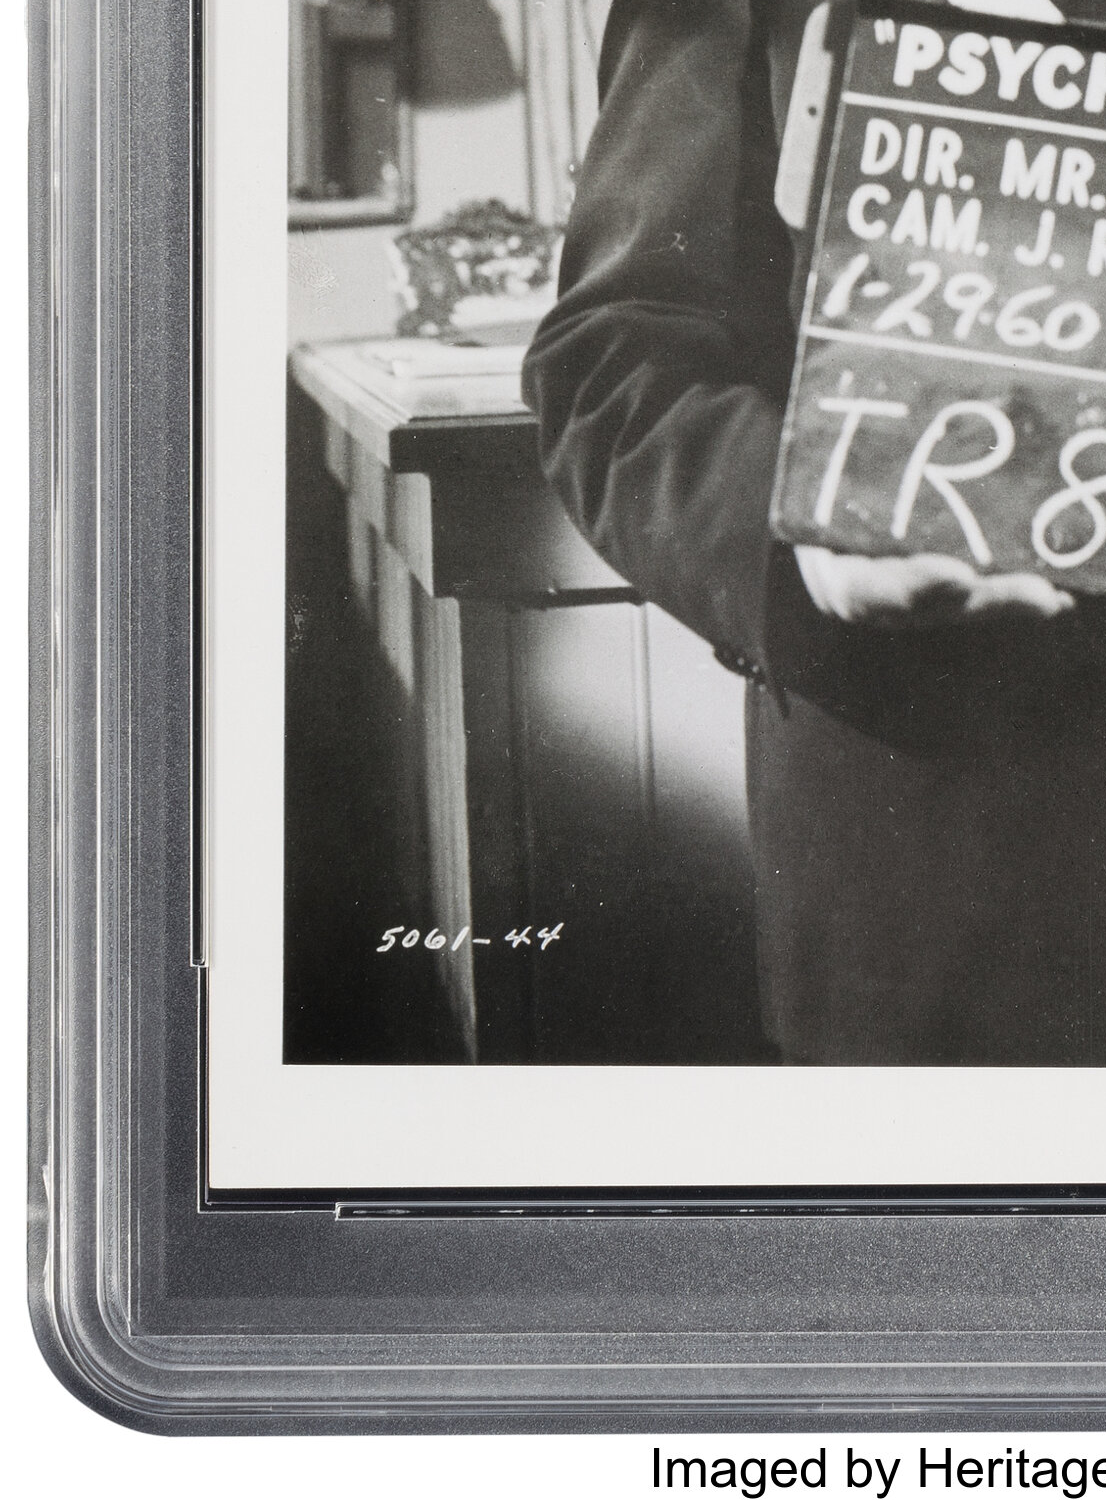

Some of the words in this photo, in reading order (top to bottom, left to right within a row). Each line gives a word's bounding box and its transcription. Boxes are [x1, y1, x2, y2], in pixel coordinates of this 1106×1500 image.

[858, 118, 975, 192] DIR.
[1000, 138, 1106, 212] MR.
[845, 184, 990, 259] CAM.
[1014, 210, 1065, 271] J.
